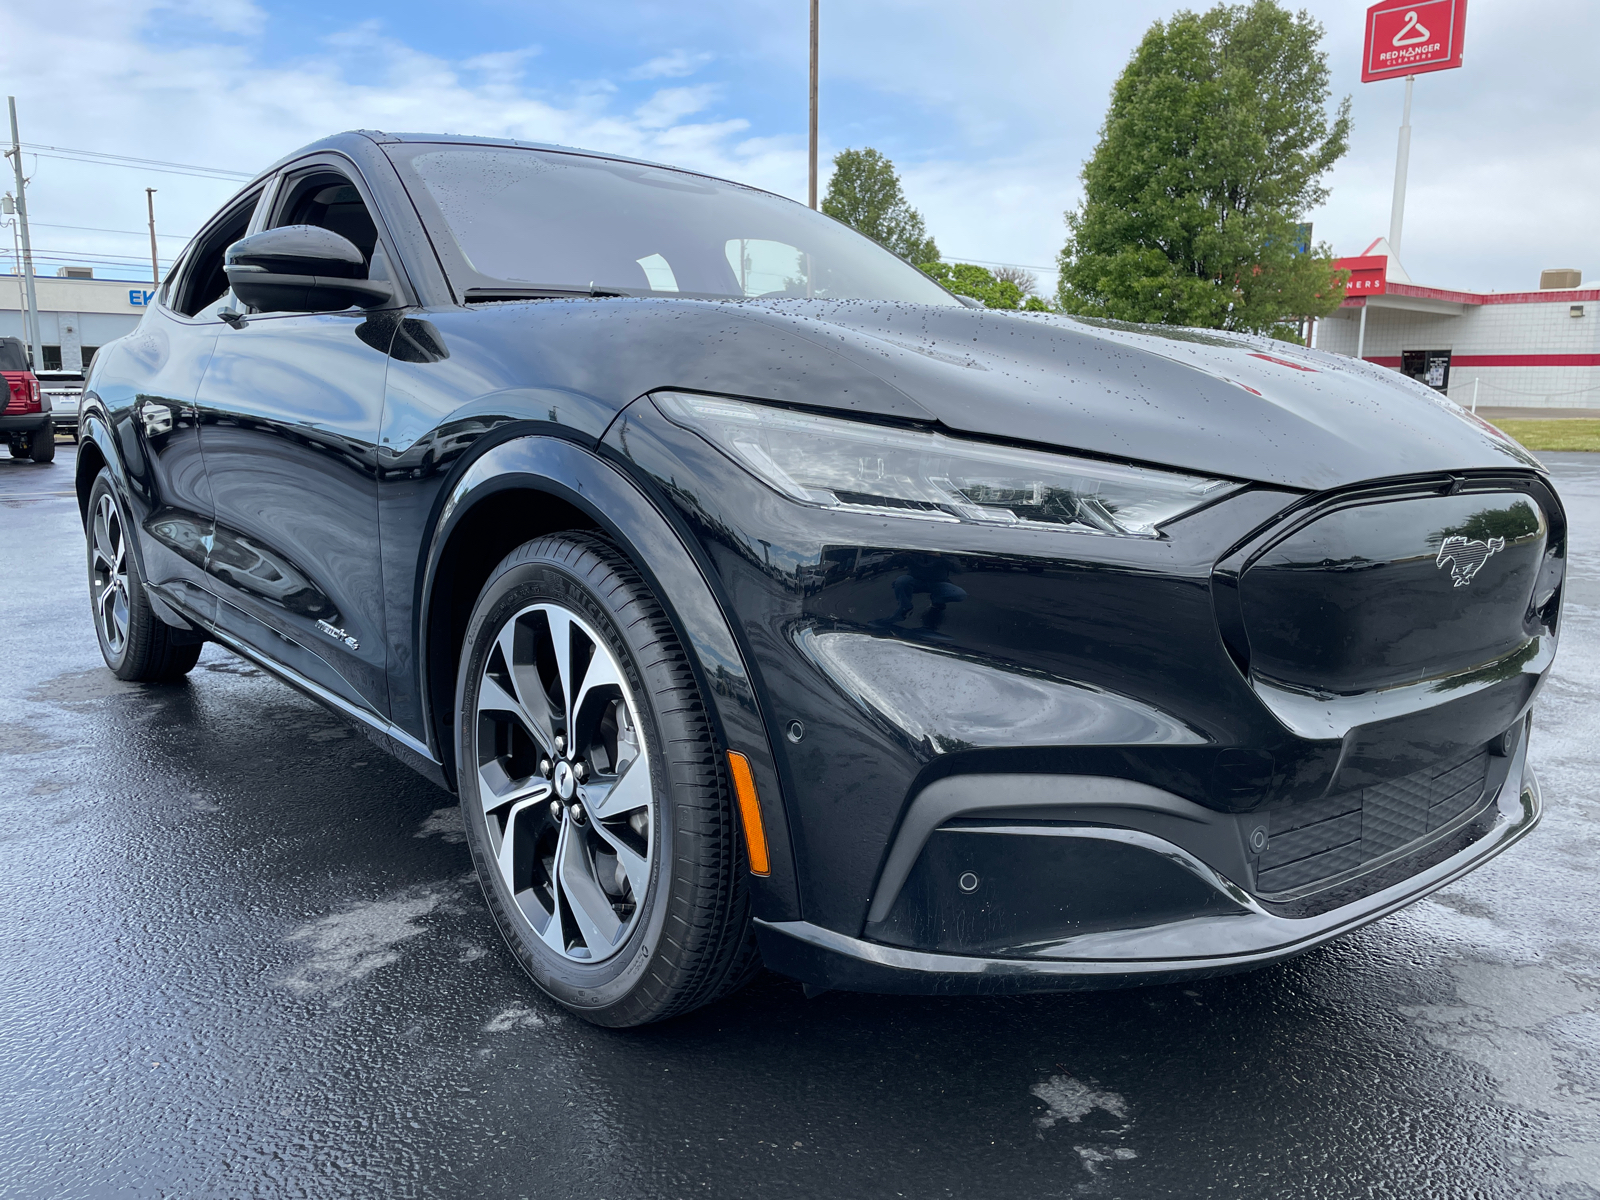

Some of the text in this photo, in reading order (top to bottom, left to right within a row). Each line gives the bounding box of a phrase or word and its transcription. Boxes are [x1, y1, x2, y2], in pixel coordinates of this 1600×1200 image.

[1380, 43, 1440, 61] RED HANGER
[1387, 53, 1431, 65] CLEANERS
[1337, 280, 1380, 289] NERS
[567, 585, 636, 682] MICHELIN
